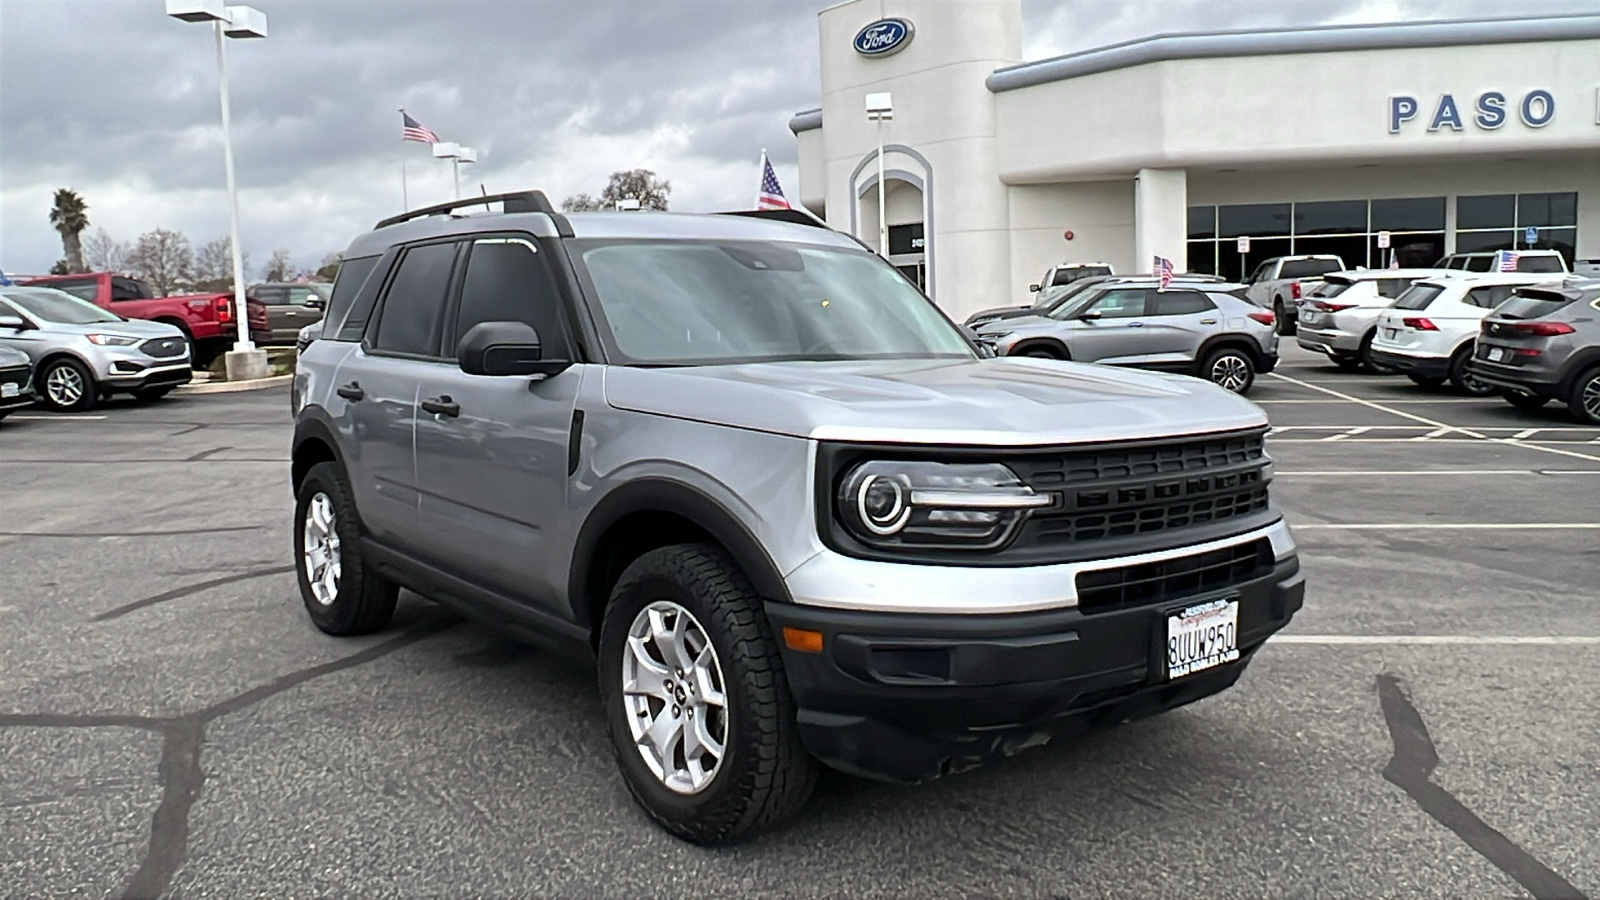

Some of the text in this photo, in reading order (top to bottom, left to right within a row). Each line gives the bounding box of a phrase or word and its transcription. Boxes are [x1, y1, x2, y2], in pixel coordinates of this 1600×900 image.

[863, 25, 896, 49] Ford
[1388, 89, 1556, 133] PASO
[1168, 621, 1234, 665] 8UUW950
